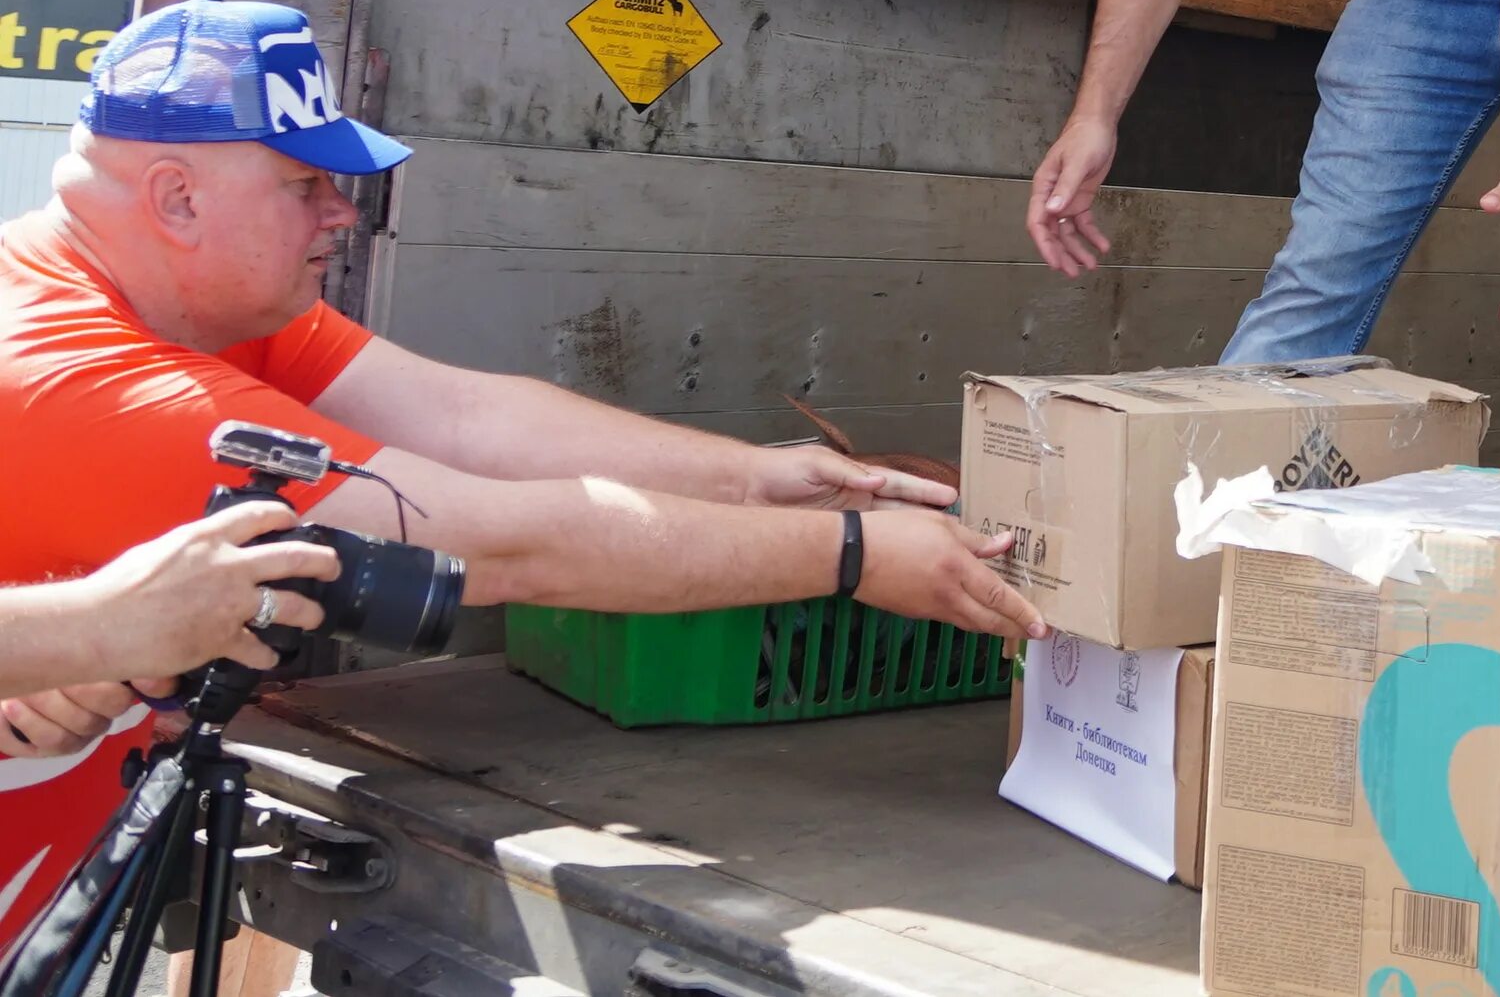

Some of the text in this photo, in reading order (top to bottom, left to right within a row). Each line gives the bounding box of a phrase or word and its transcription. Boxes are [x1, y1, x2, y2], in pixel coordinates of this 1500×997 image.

[614, 1, 664, 15] CARGOBULL
[1045, 704, 1074, 733] Книги
[1082, 722, 1148, 766] библиотекам
[1075, 741, 1116, 776] Донецка
